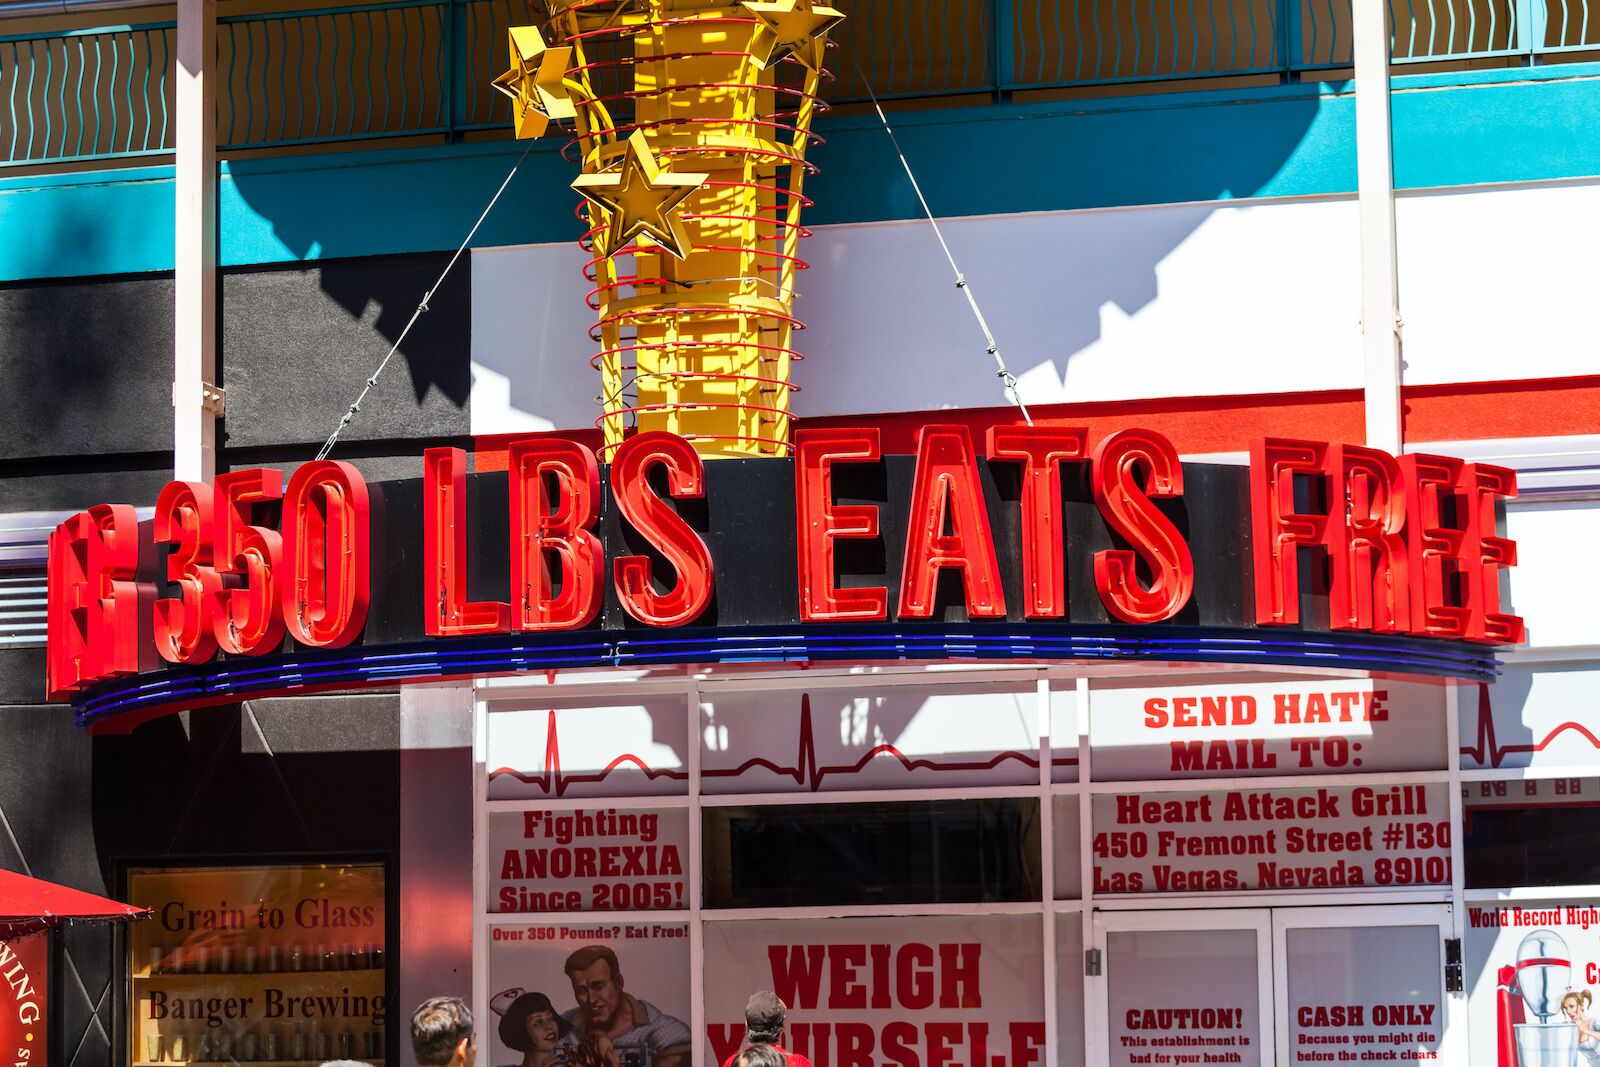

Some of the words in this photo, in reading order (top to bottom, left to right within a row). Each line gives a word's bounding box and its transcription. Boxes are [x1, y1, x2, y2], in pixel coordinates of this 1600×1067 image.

[154, 460, 370, 663] 350
[424, 430, 714, 637] LBS
[795, 424, 1194, 625] EATS
[1250, 436, 1525, 646] FREE
[1144, 697, 1257, 729] SEND
[1274, 690, 1389, 725] HATE
[1170, 738, 1277, 771] MAIL
[1290, 735, 1363, 768] TO:
[1116, 795, 1212, 824] Heart
[1223, 789, 1339, 820] Attack
[1352, 785, 1427, 817] Grill
[523, 808, 658, 844] Fighting
[1093, 831, 1148, 858] 450
[1158, 829, 1277, 857] Fremont
[1286, 826, 1373, 853] Street
[1382, 821, 1451, 850] #130
[501, 845, 682, 880] ANOREXIA
[1093, 866, 1143, 892] Las
[1258, 859, 1364, 889] Nevada
[499, 886, 582, 912] Since
[592, 882, 683, 910] 2005!
[161, 900, 246, 932] Grain
[257, 903, 284, 930] to
[295, 899, 375, 929] Glass
[1469, 905, 1508, 928] World
[1513, 906, 1561, 926] Record
[1566, 904, 1600, 930] High
[492, 928, 524, 941] Over
[527, 927, 555, 940] 350
[560, 926, 621, 939] Pounds?
[625, 926, 648, 938] Eat
[652, 924, 689, 938] Free!
[768, 943, 982, 1009] WEIGH
[149, 990, 253, 1027] Banger
[265, 987, 385, 1024] Brewing
[1126, 1008, 1243, 1030] CAUTION!
[1298, 1006, 1364, 1027] CASH
[1372, 1005, 1435, 1026] ONLY
[707, 1021, 1046, 1067] YURSELF
[1121, 1036, 1147, 1047] This
[1151, 1035, 1236, 1046] establishment
[1239, 1035, 1250, 1045] is
[1297, 1050, 1334, 1061] before
[1338, 1050, 1357, 1060] the
[1361, 1050, 1397, 1060] check
[1401, 1049, 1437, 1060] clears
[1298, 1033, 1349, 1044] Because
[1353, 1034, 1375, 1045] you
[1378, 1032, 1413, 1045] might
[1417, 1032, 1435, 1042] die
[1130, 1053, 1151, 1063] bad
[1155, 1053, 1171, 1063] for
[1175, 1055, 1200, 1065] your
[1203, 1052, 1241, 1063] health
